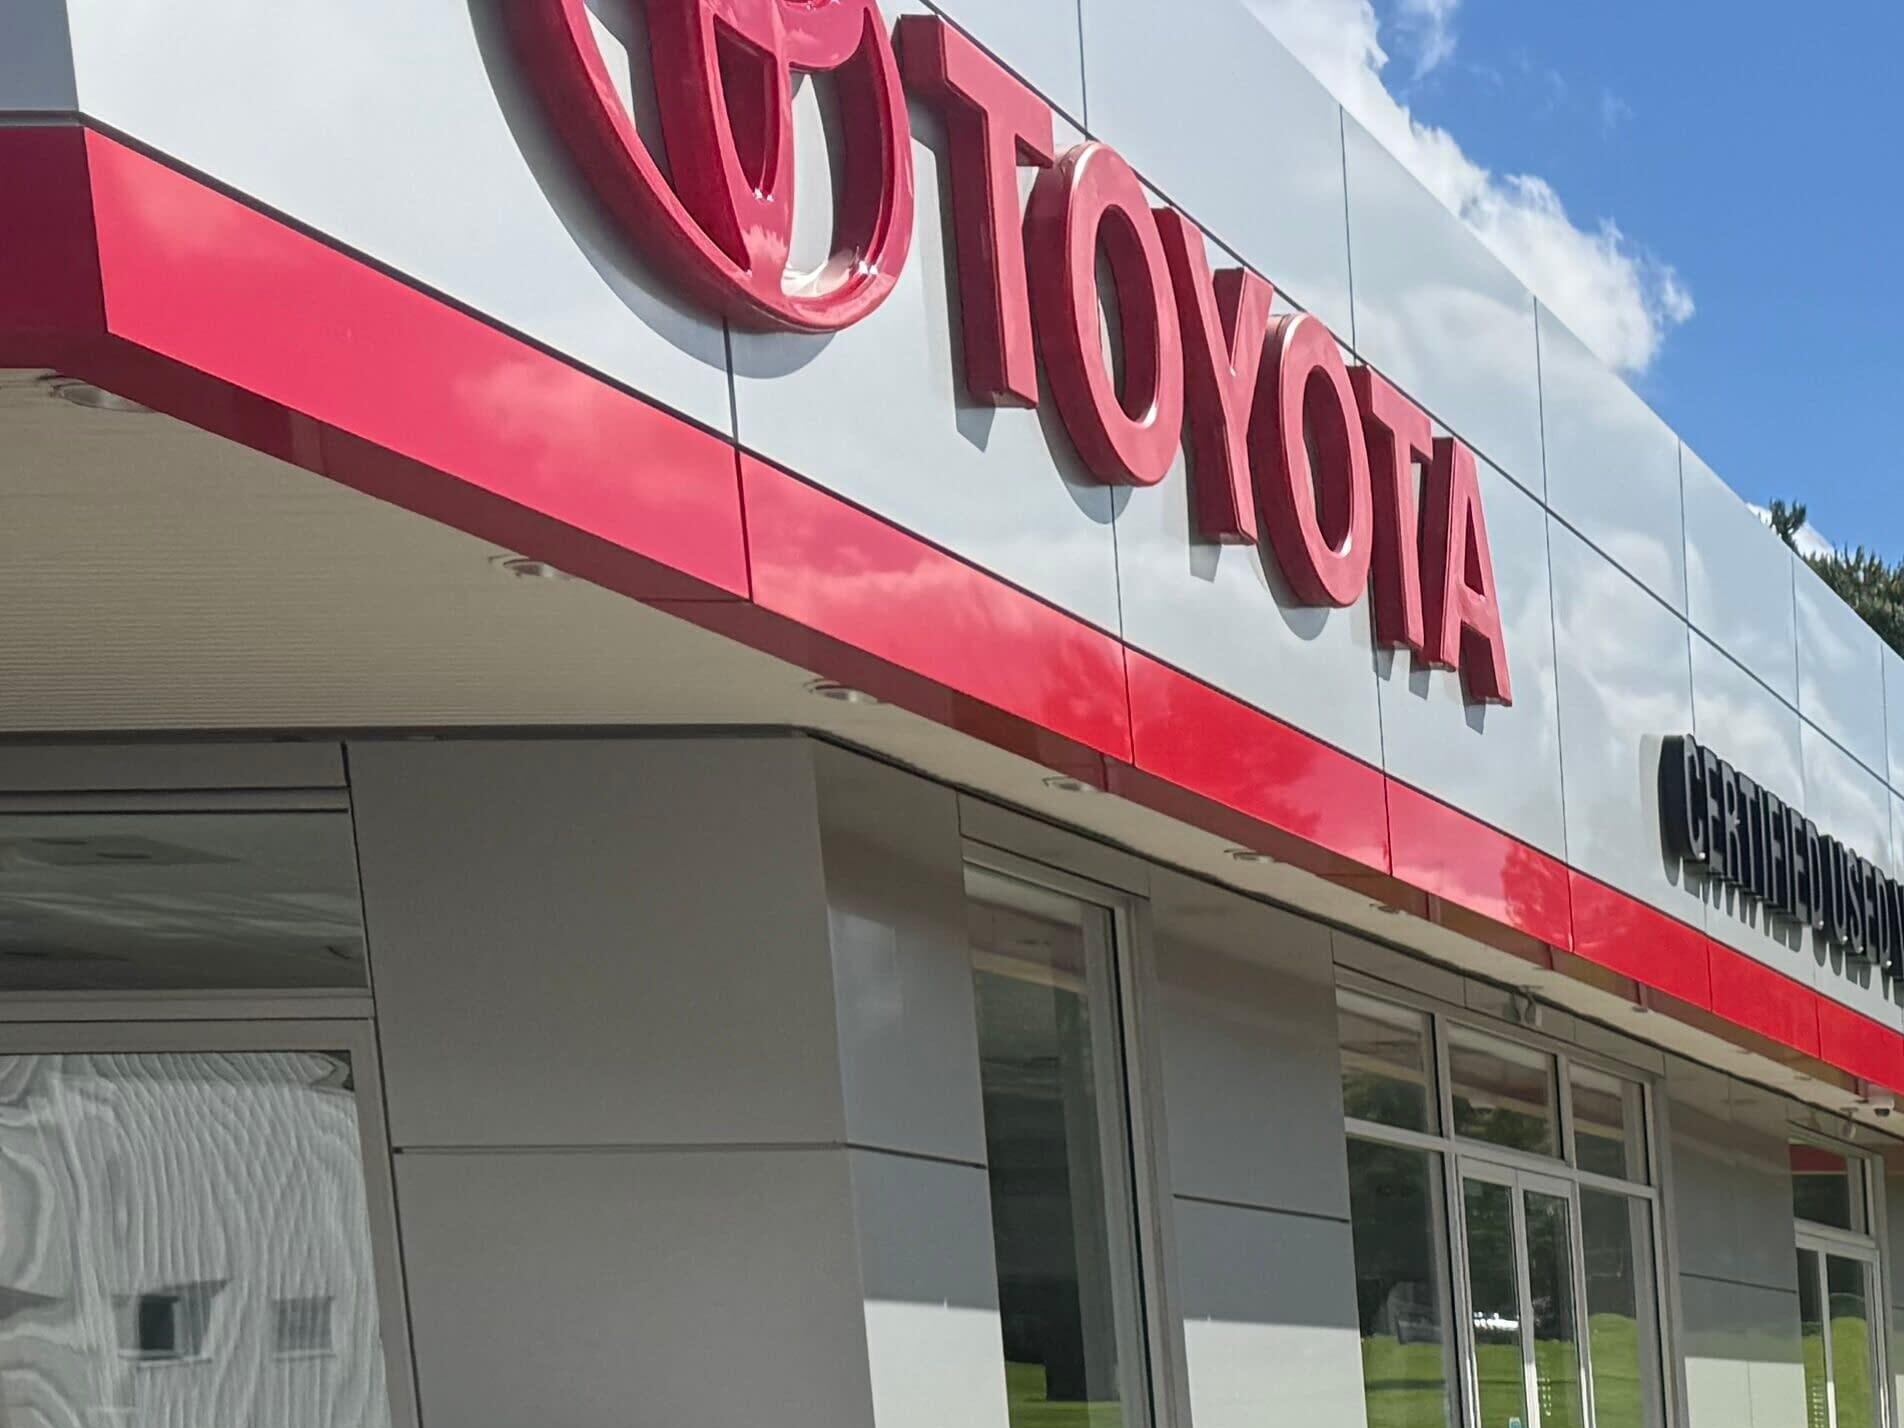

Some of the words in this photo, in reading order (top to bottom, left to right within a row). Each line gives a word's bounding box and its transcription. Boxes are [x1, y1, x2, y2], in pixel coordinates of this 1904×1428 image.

[893, 14, 1513, 707] TOYOTA
[1660, 733, 1825, 930] CERTIFIED
[1822, 834, 1892, 971] USED
